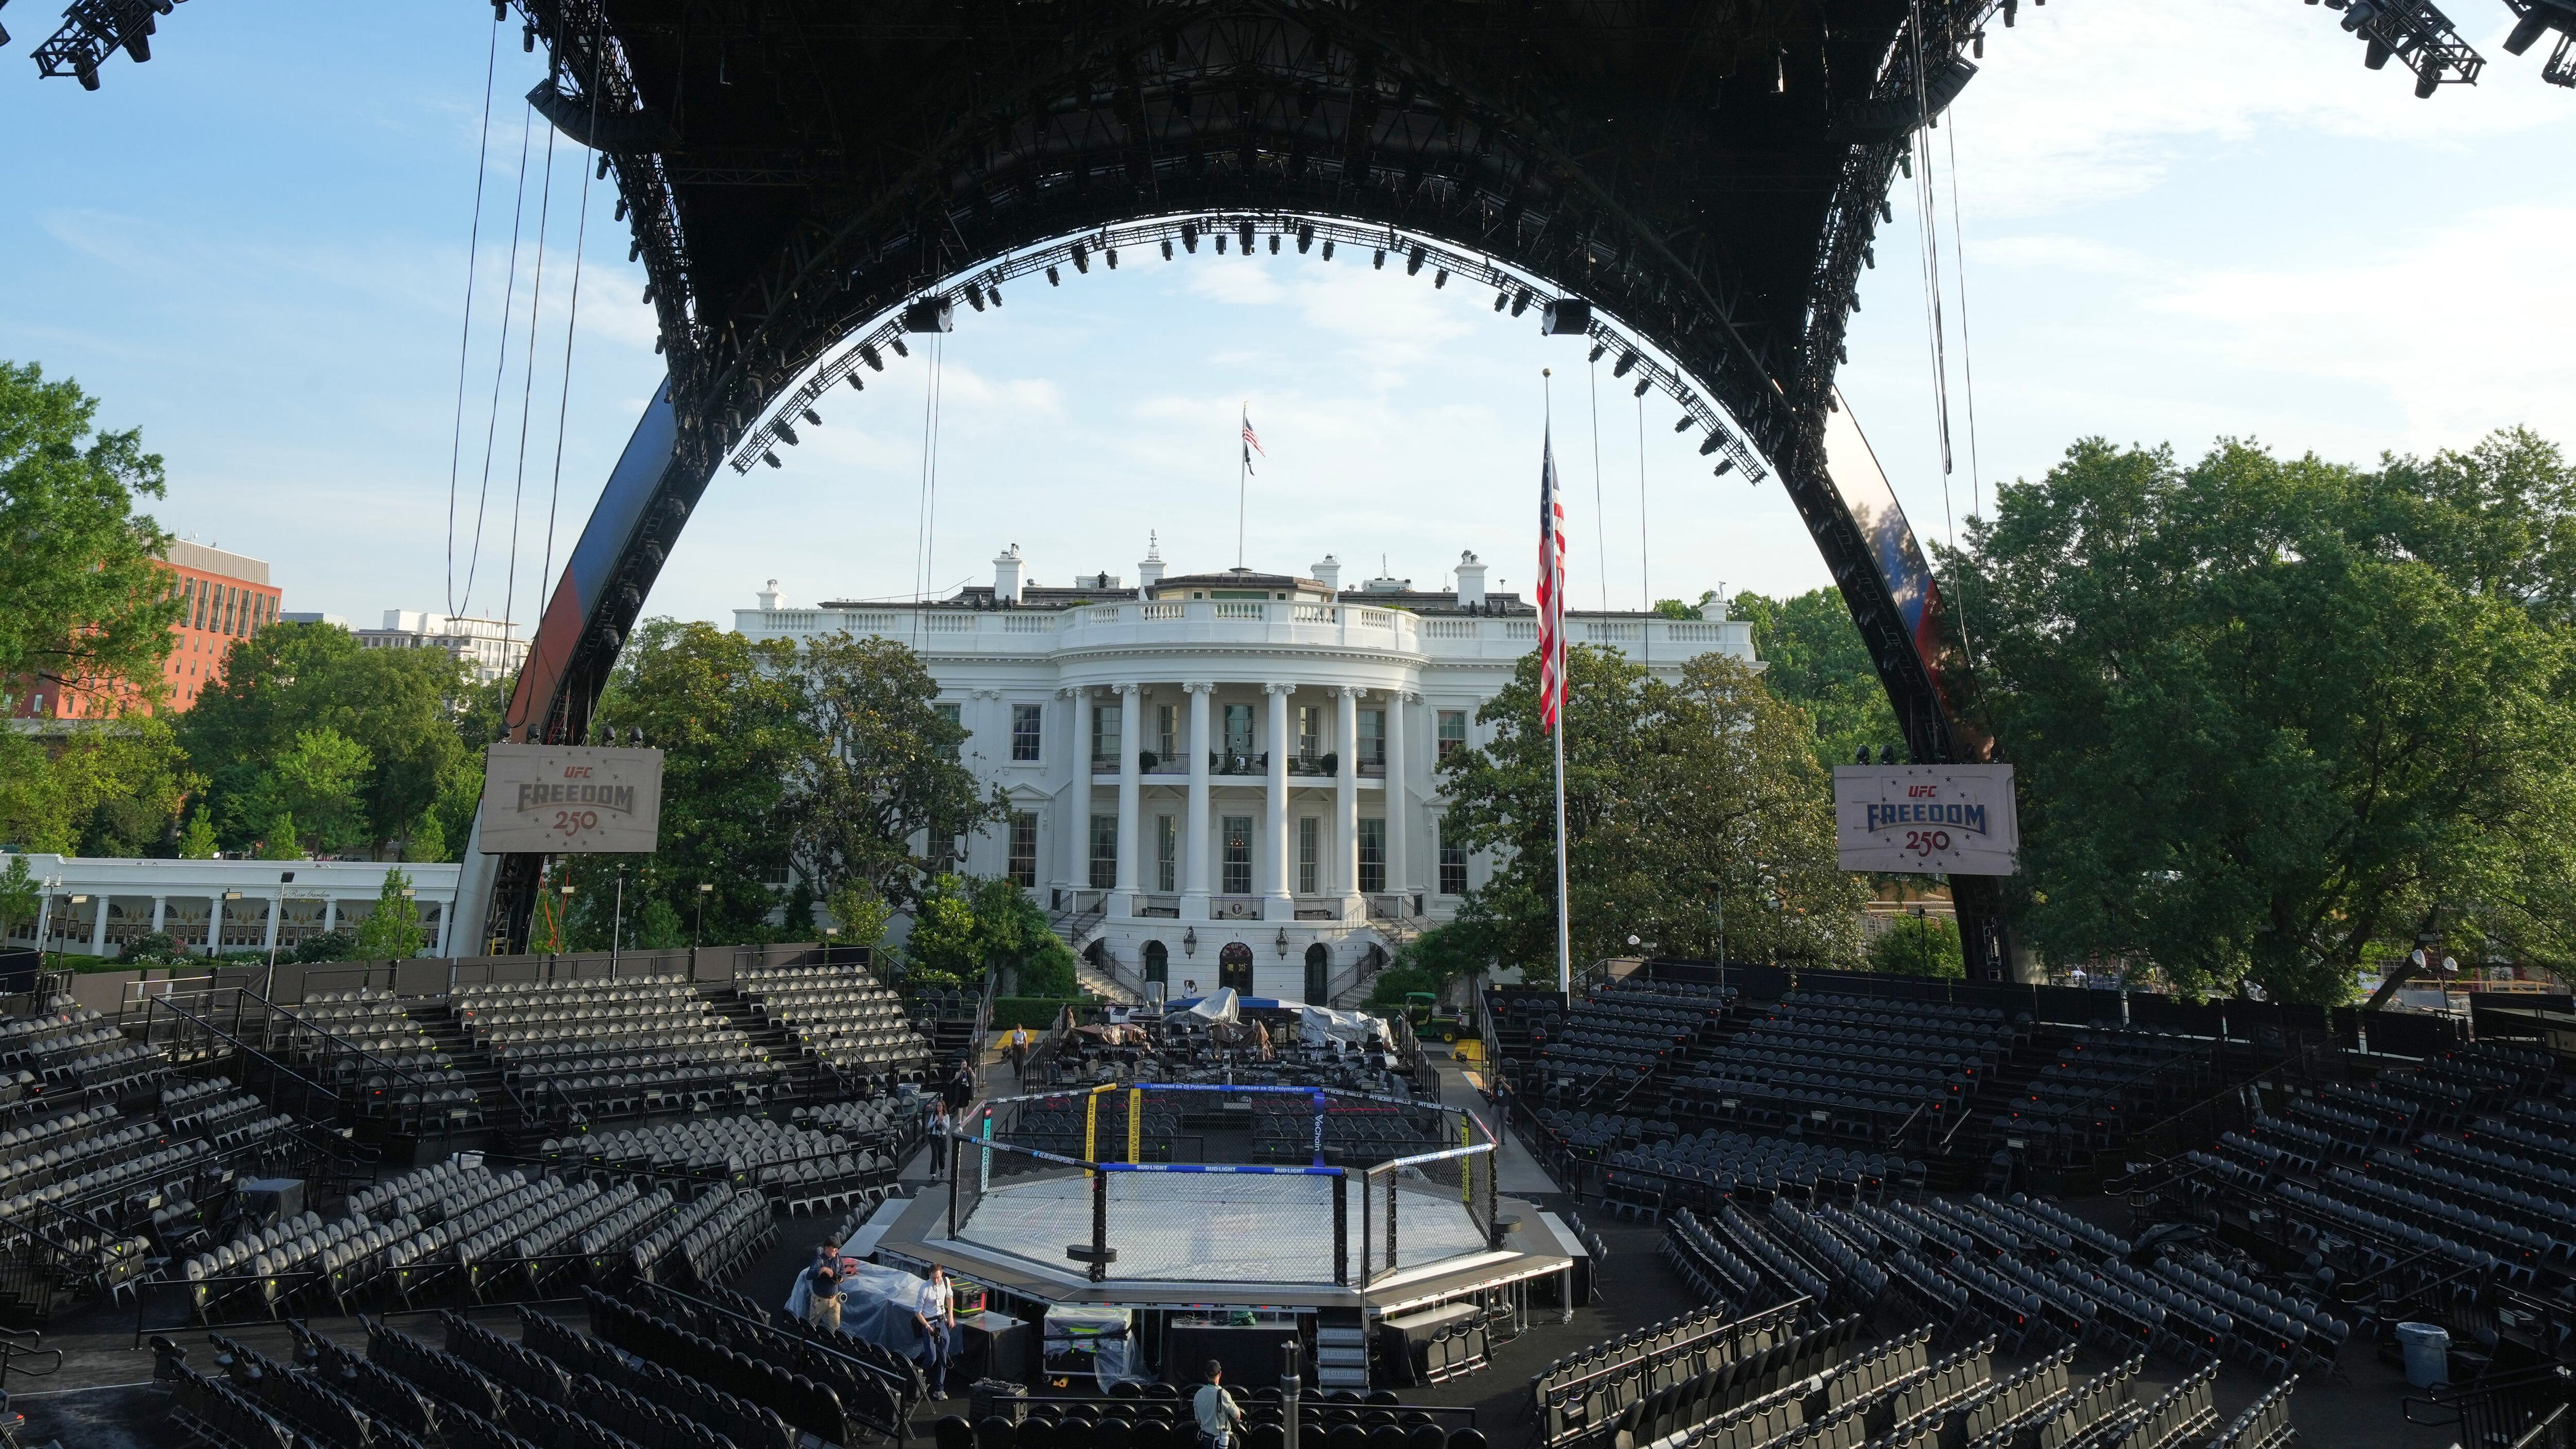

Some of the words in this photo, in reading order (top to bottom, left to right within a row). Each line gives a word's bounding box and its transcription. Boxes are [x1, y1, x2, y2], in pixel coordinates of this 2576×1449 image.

[564, 766, 593, 778] UFC
[516, 783, 635, 815] FREEDOM
[1908, 785, 1937, 798] UFC
[553, 811, 598, 837] 250
[1867, 804, 1987, 835] FREEDOM
[1905, 830, 1950, 857] 250
[274, 889, 287, 897] Te
[288, 889, 305, 897] Rose
[1314, 1114, 1323, 1151] VeChain
